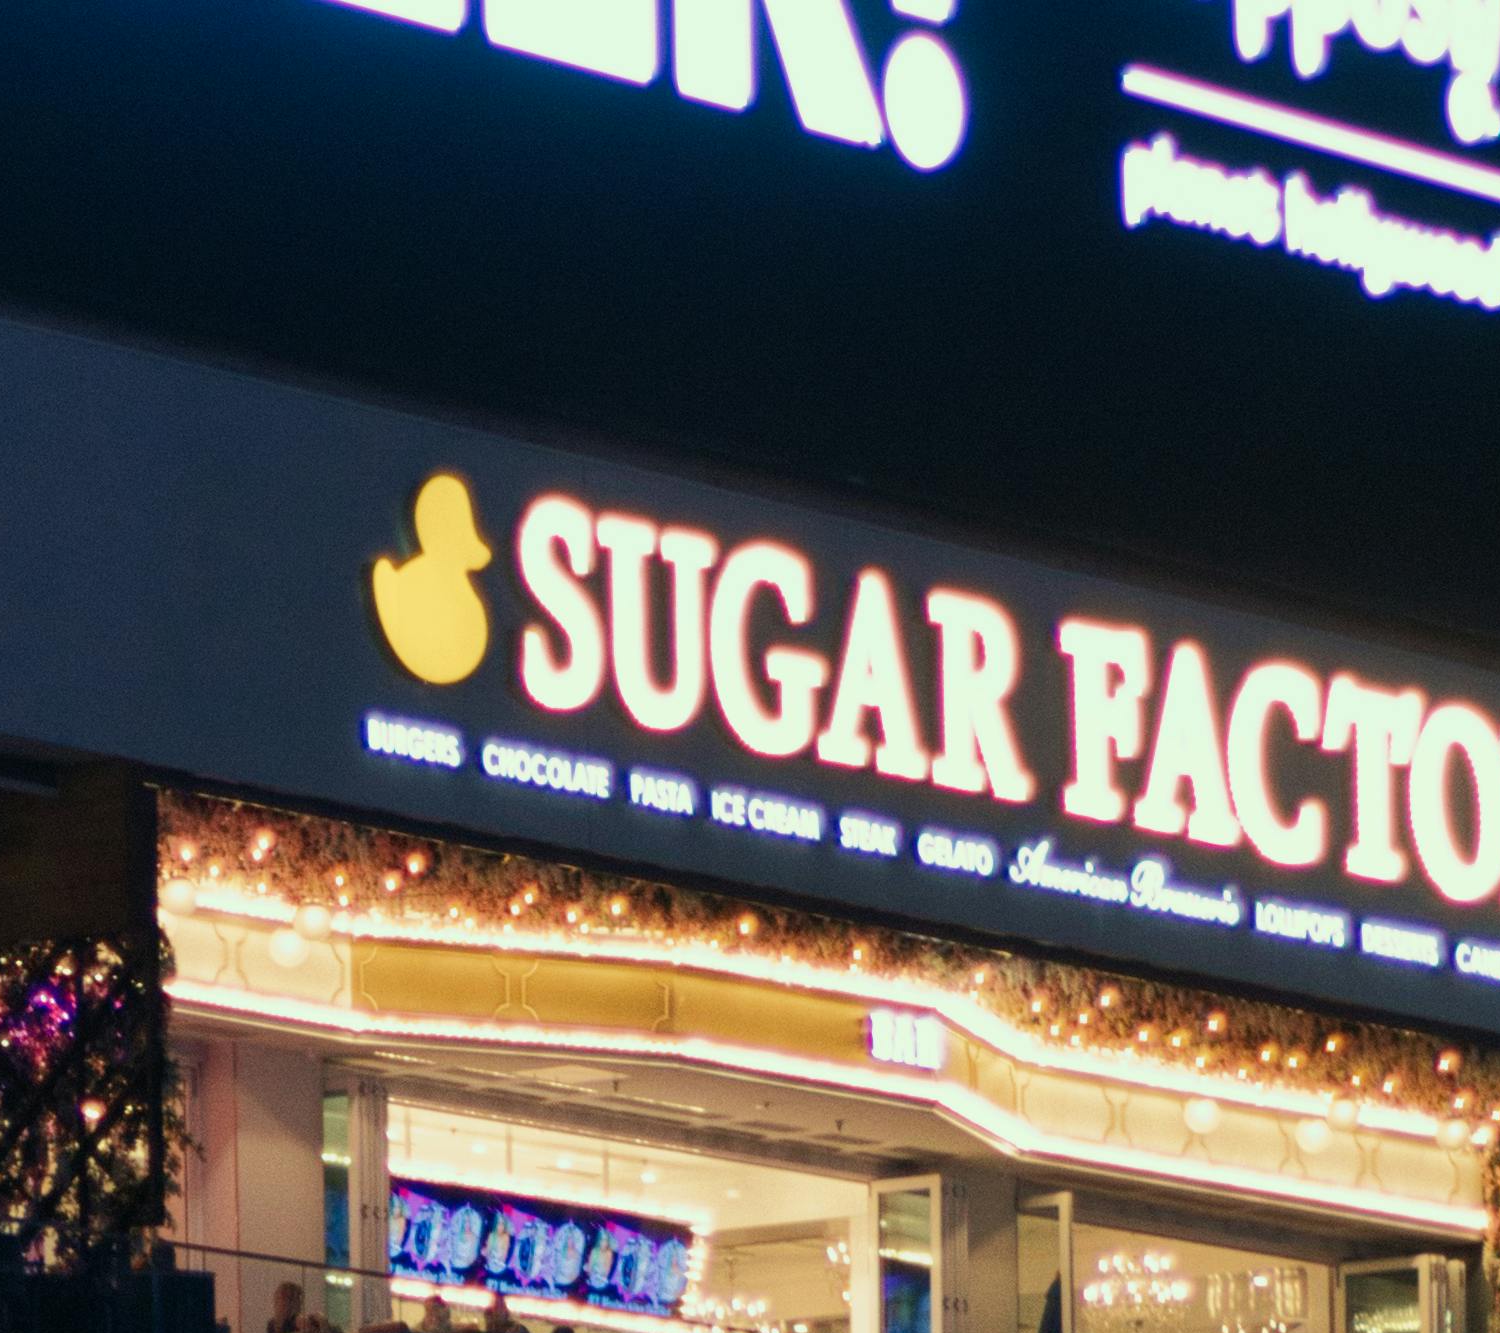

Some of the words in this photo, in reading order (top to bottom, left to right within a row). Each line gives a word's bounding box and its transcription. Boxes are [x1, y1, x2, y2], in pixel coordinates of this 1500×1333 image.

[516, 498, 1031, 806] SUGAR
[366, 718, 462, 769] BURGERS
[481, 743, 613, 799] CHOCOLATE
[629, 773, 695, 815] PASTA
[711, 790, 746, 825] ICE
[747, 798, 822, 840] CREAM
[839, 815, 898, 856] STEAK
[916, 832, 995, 876] GELATO
[870, 1009, 946, 1069] BAR
